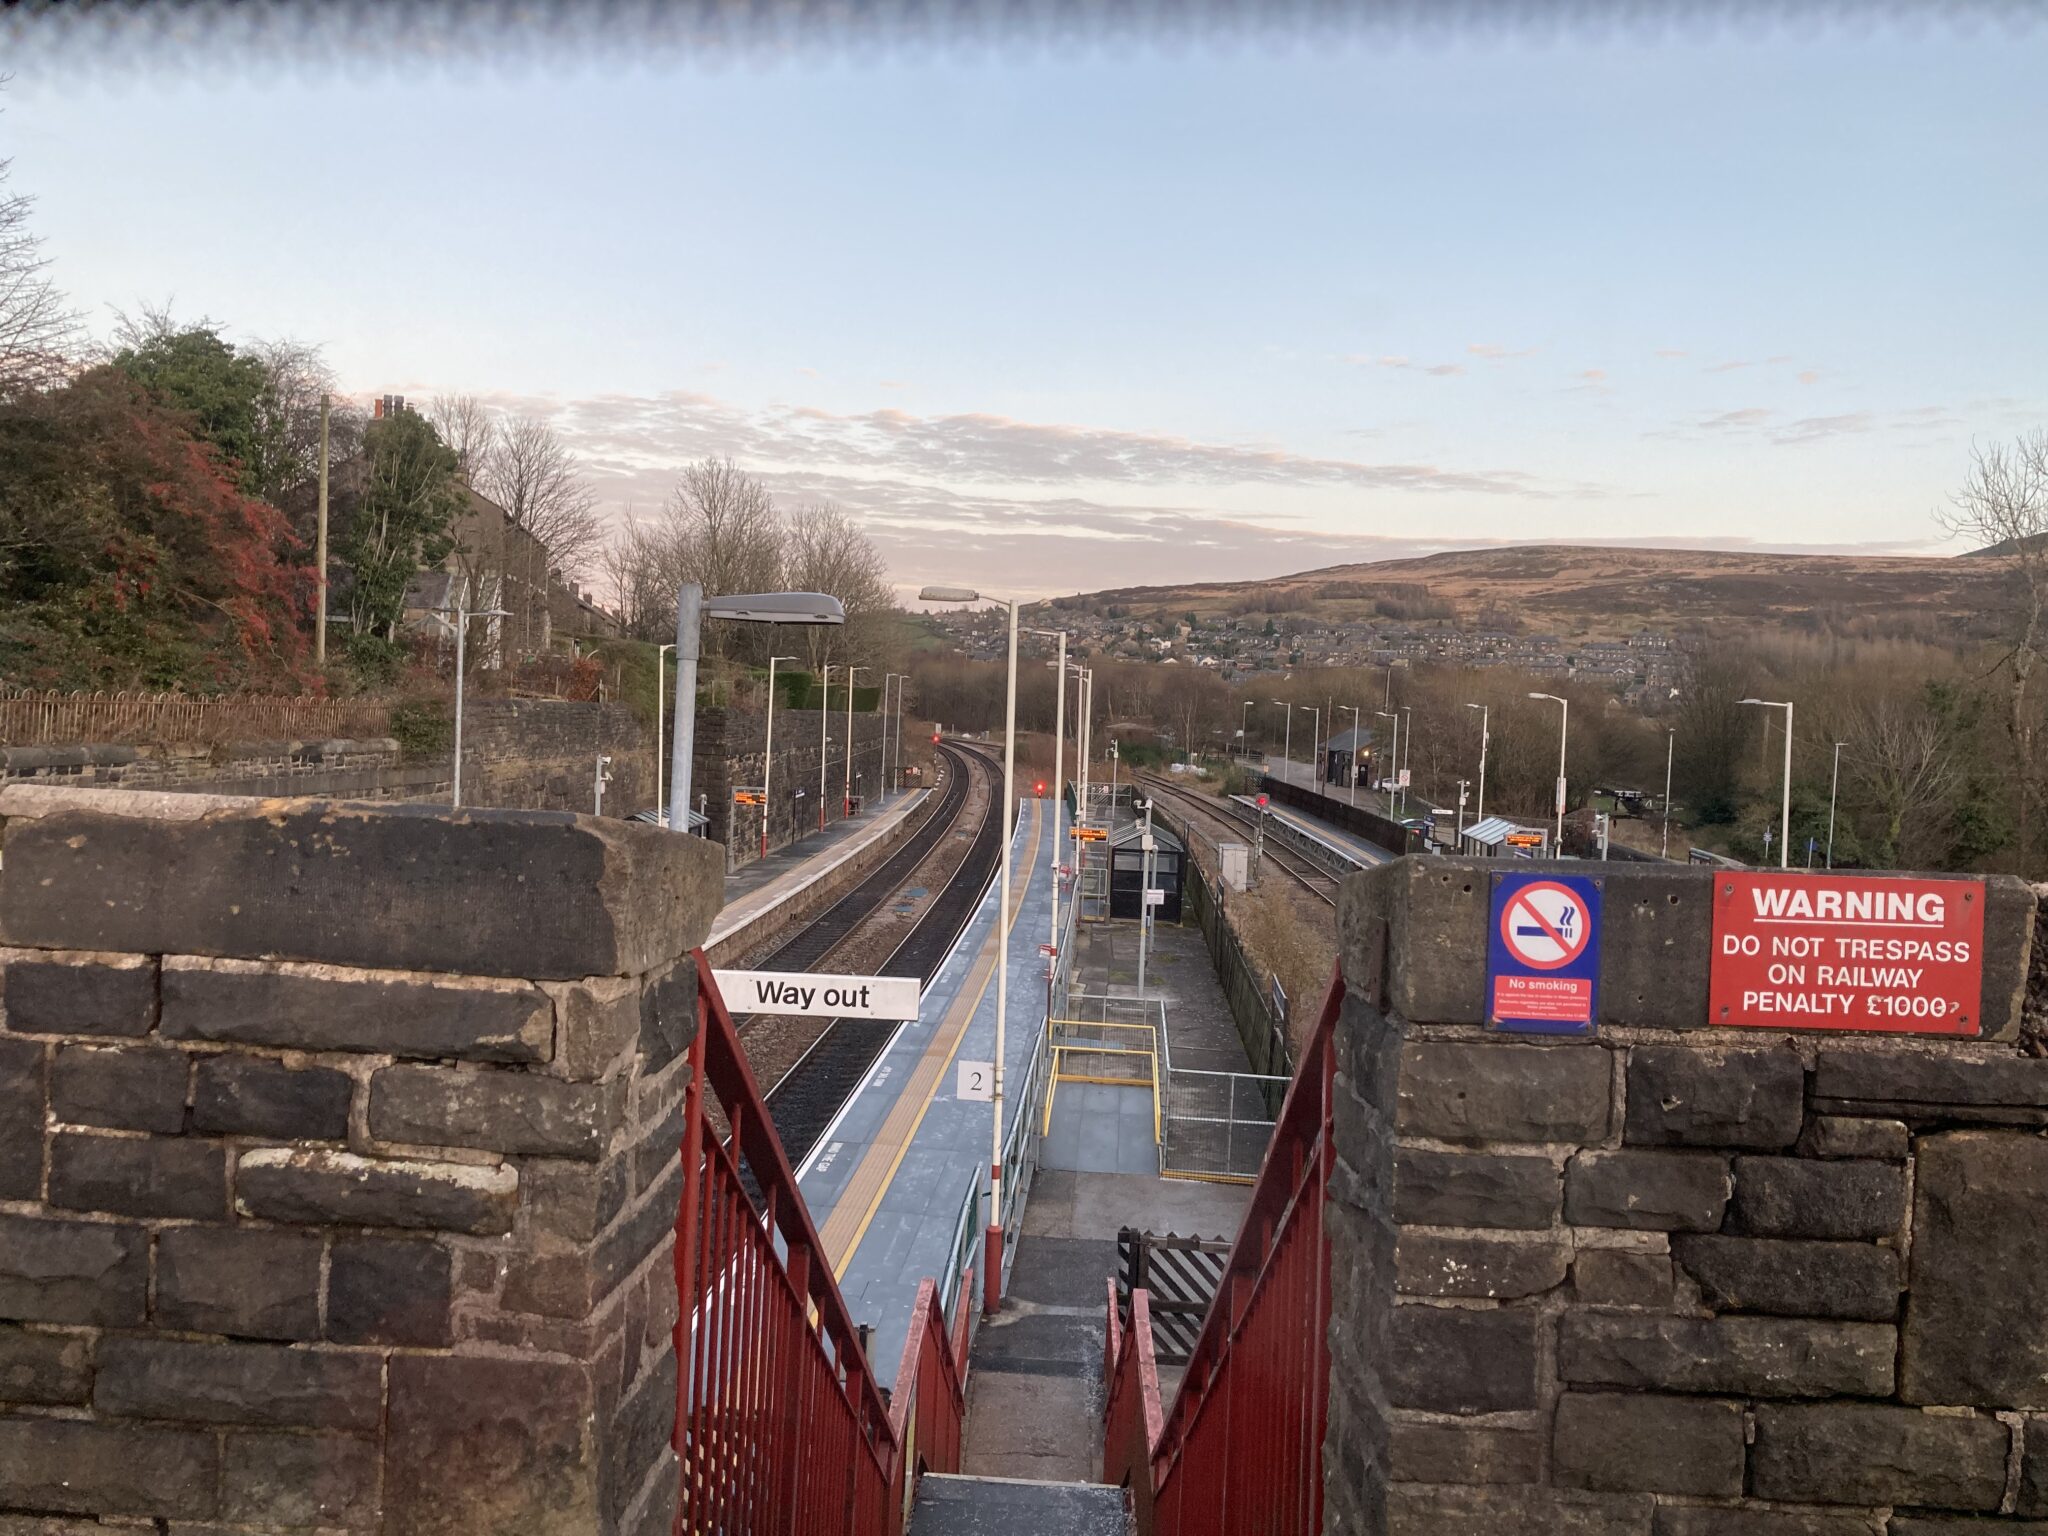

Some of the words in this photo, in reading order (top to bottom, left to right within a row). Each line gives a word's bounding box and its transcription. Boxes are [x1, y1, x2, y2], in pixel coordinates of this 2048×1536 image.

[1752, 888, 1945, 922] WARNING
[1722, 935, 1761, 955] DO
[1772, 937, 1825, 957] NOT
[1835, 939, 1970, 963] TRESPASS
[1509, 978, 1525, 989] No
[1528, 980, 1578, 994] smoking
[1768, 964, 1805, 985] ON
[1818, 967, 1923, 988] RAILWAY
[756, 980, 816, 1010] Way
[823, 985, 870, 1009] out
[1743, 992, 1855, 1014] PENALTY
[970, 1072, 982, 1092] 2
